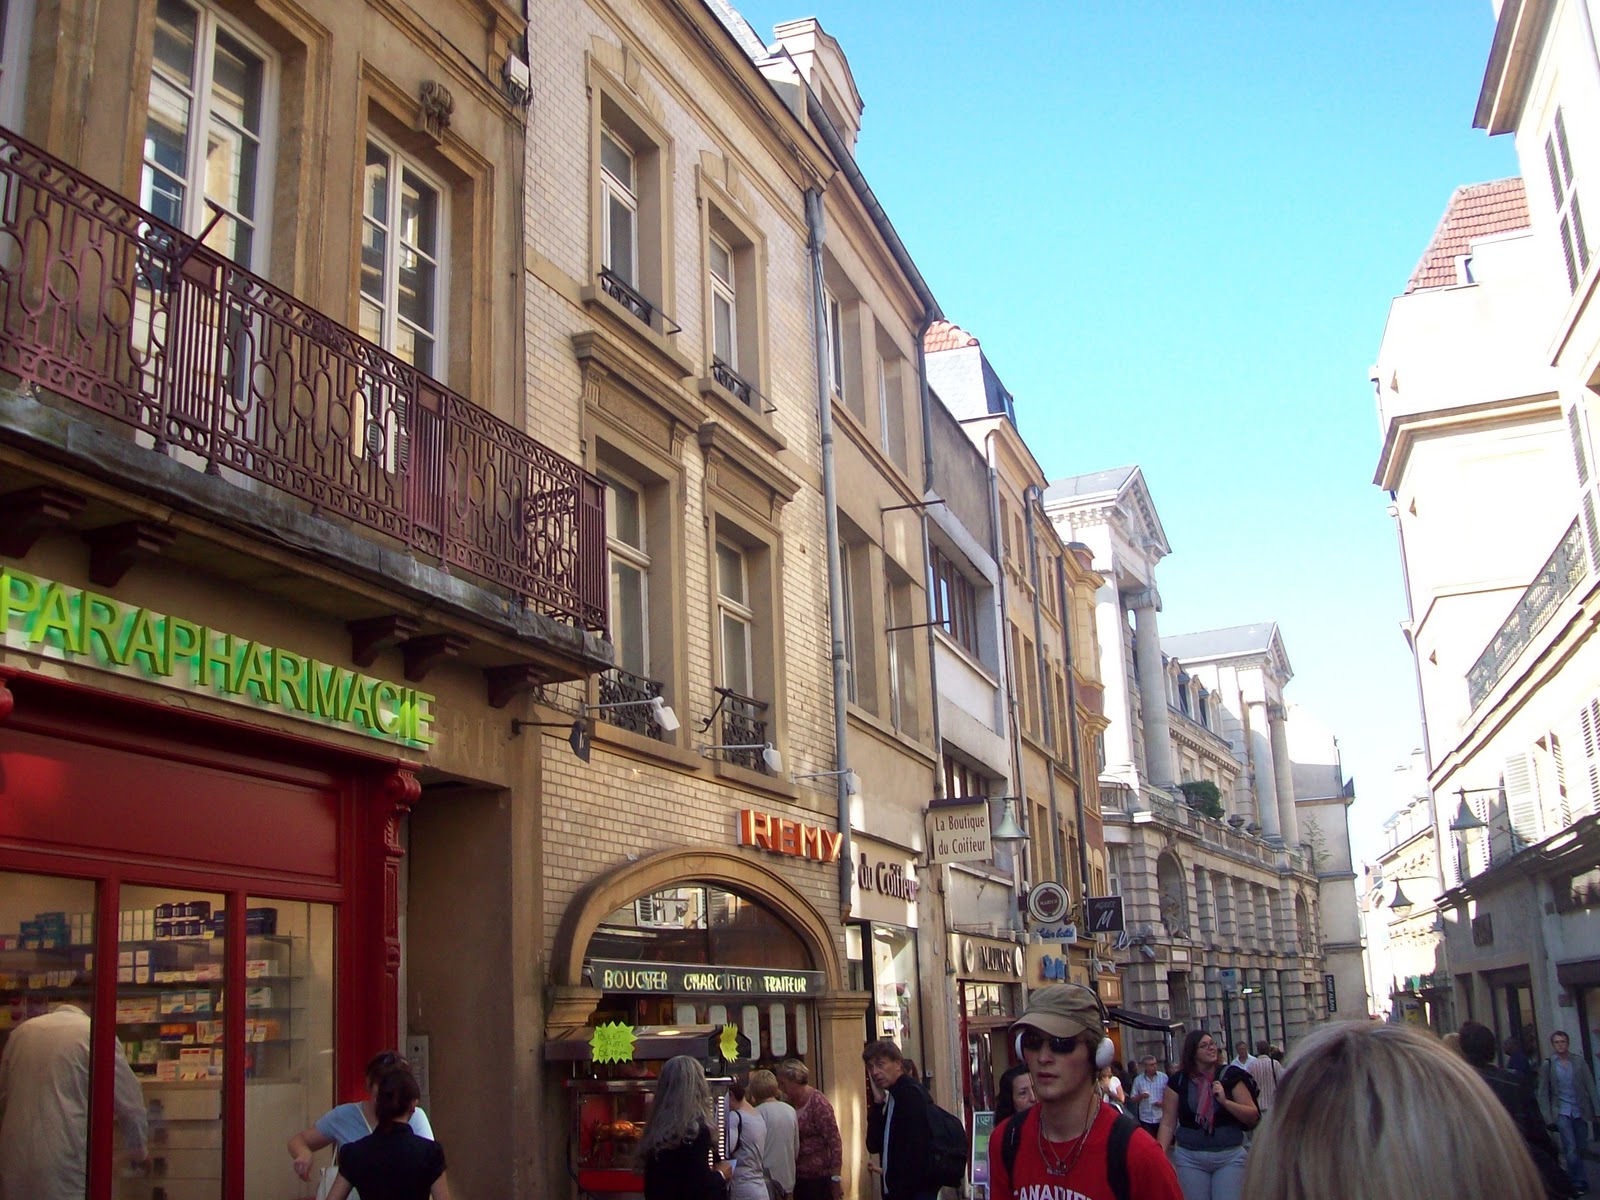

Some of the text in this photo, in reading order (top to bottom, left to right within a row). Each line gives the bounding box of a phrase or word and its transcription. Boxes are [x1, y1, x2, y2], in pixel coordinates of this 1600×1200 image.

[0, 566, 436, 745] PARAPHARMACIE
[935, 813, 985, 832] La Boutique
[738, 809, 843, 862] REMY
[938, 837, 985, 855] du Coiffeur
[858, 852, 873, 891] du
[1095, 909, 1114, 930] M
[683, 973, 752, 993] CHARCUTIER
[763, 975, 807, 993] TRAITEUR
